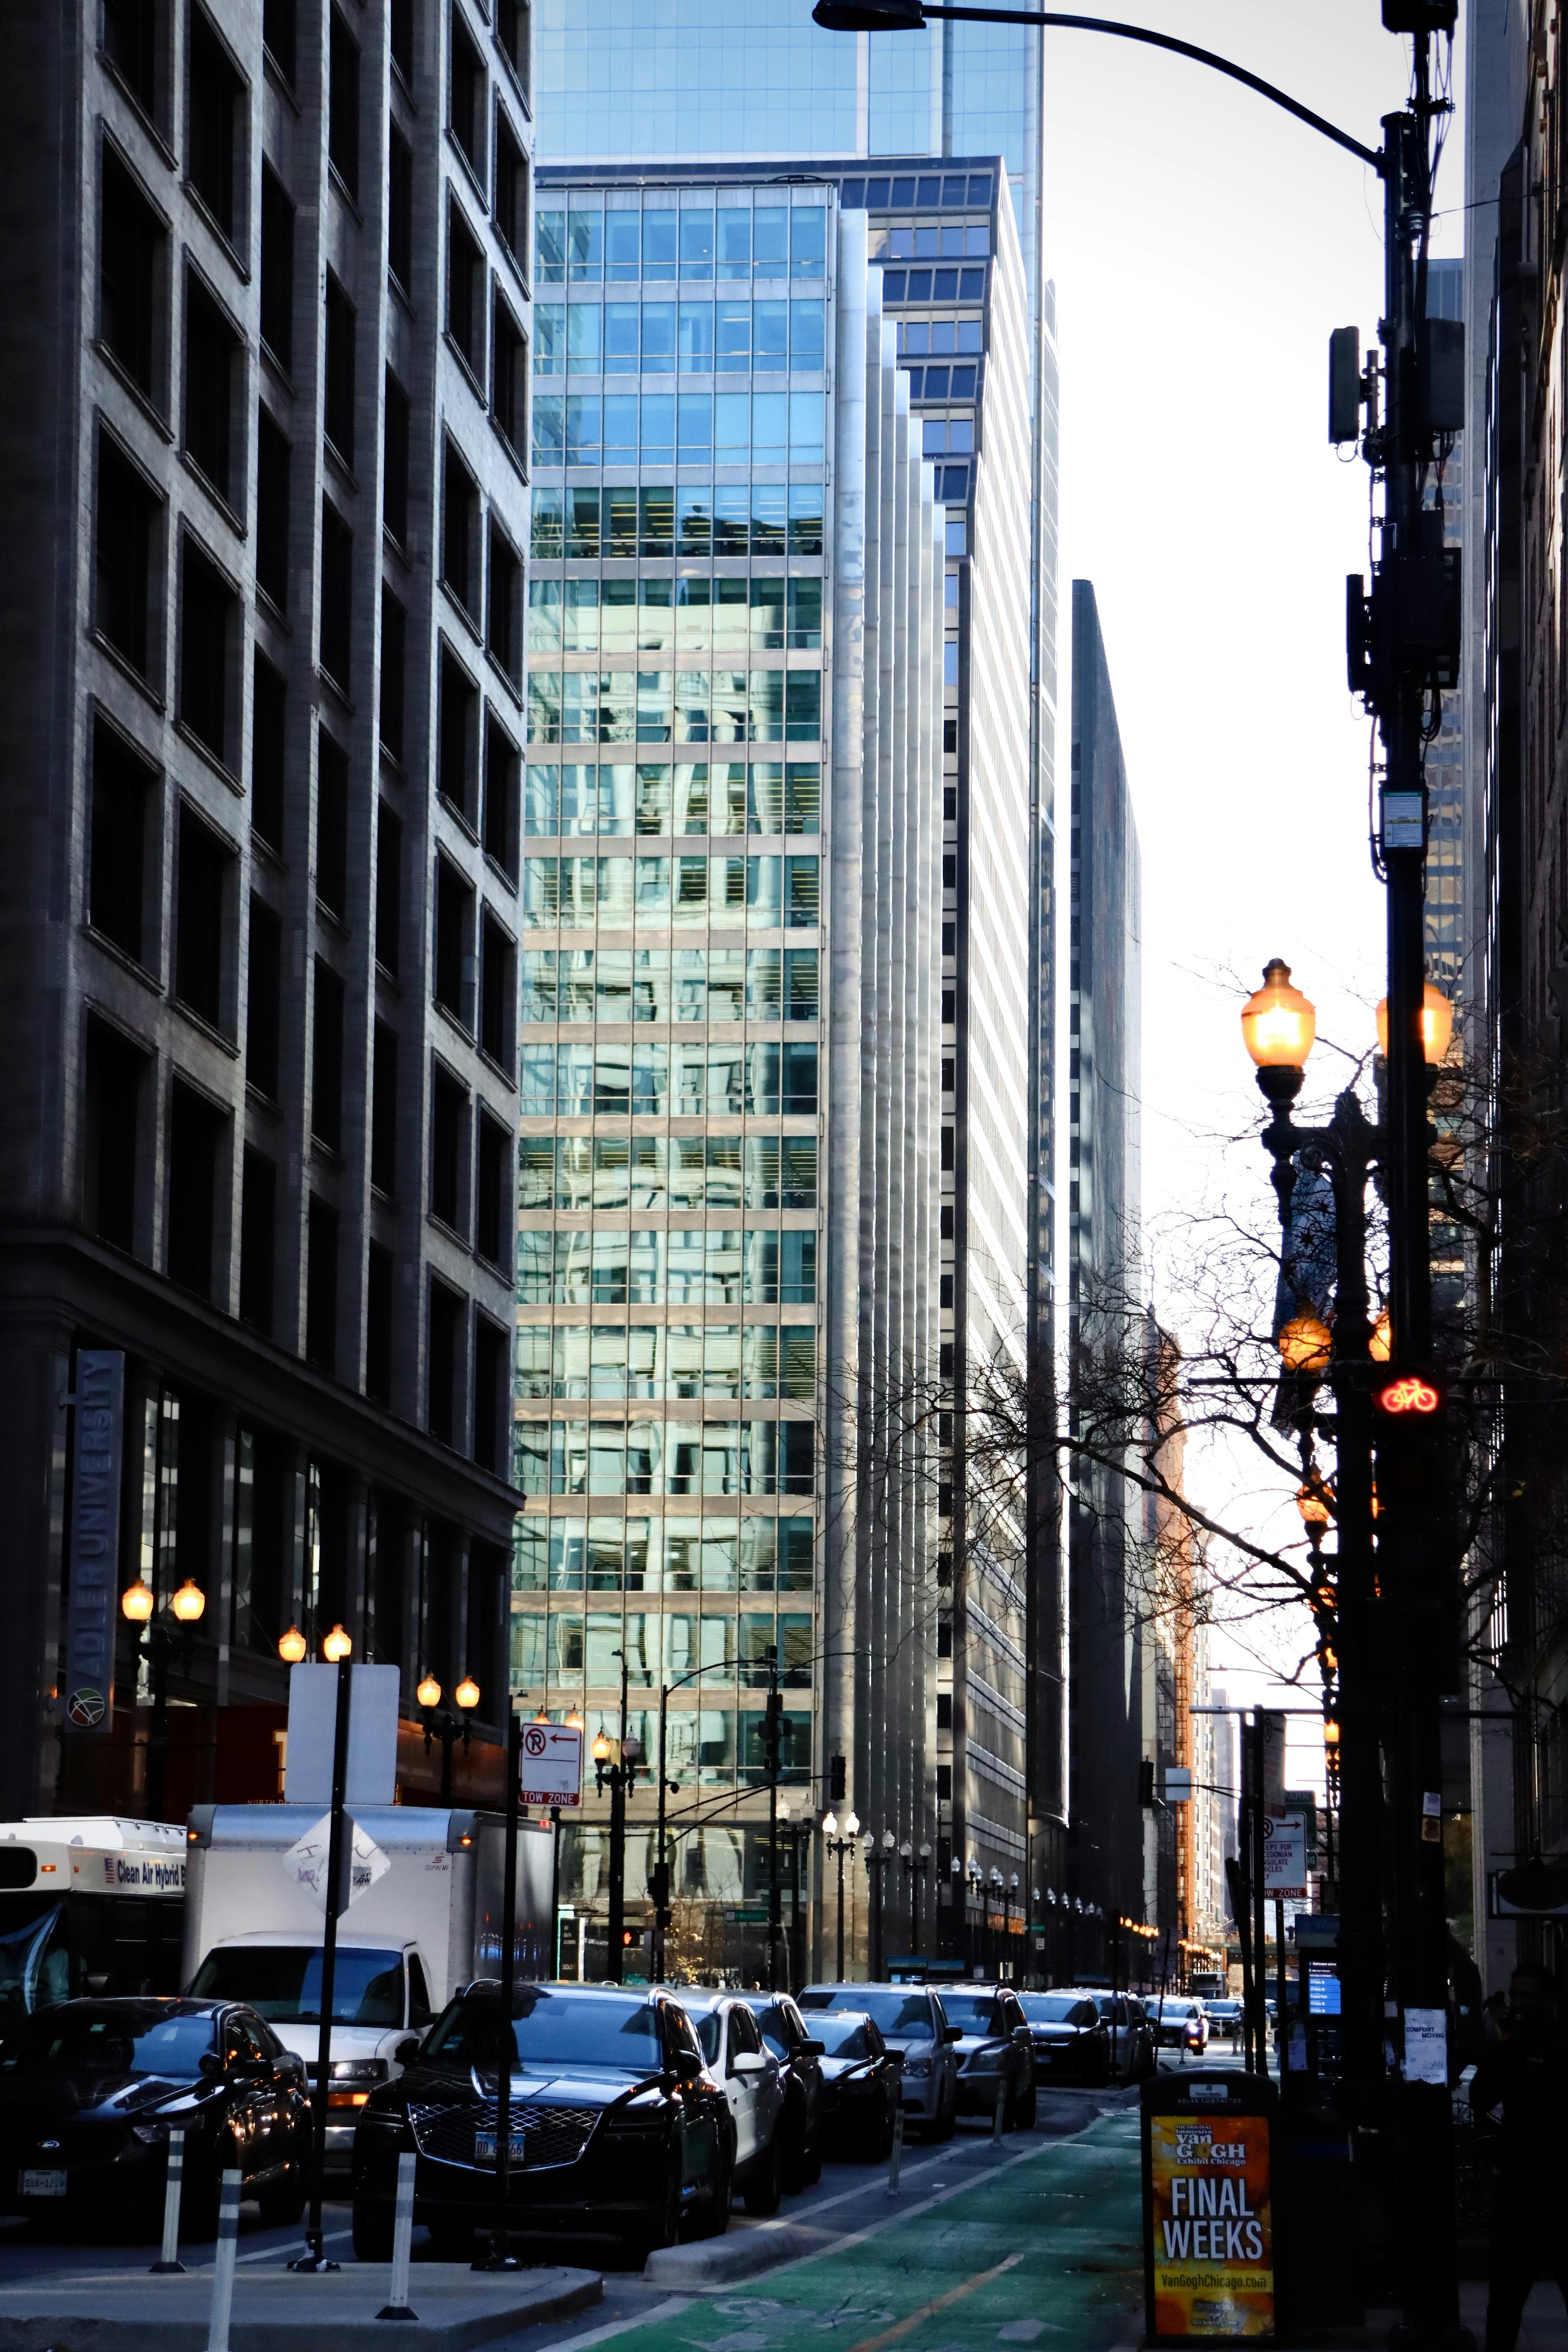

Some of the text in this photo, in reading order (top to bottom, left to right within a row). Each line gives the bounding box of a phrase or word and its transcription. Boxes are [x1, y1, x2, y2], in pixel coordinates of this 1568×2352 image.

[74, 1359, 113, 1680] ADLER UNIVERSITY
[523, 1792, 574, 1804] TOW ZONE
[118, 1859, 140, 1883] Clean
[142, 1862, 153, 1884] Air
[155, 1863, 179, 1890] Hybrid
[1278, 1888, 1302, 1897] ZONE
[1211, 2158, 1246, 2167] Chicago
[1172, 2177, 1254, 2217] FINAL
[1163, 2220, 1263, 2260] WEEKS
[1161, 2274, 1267, 2290] VanGoghChicago.com
